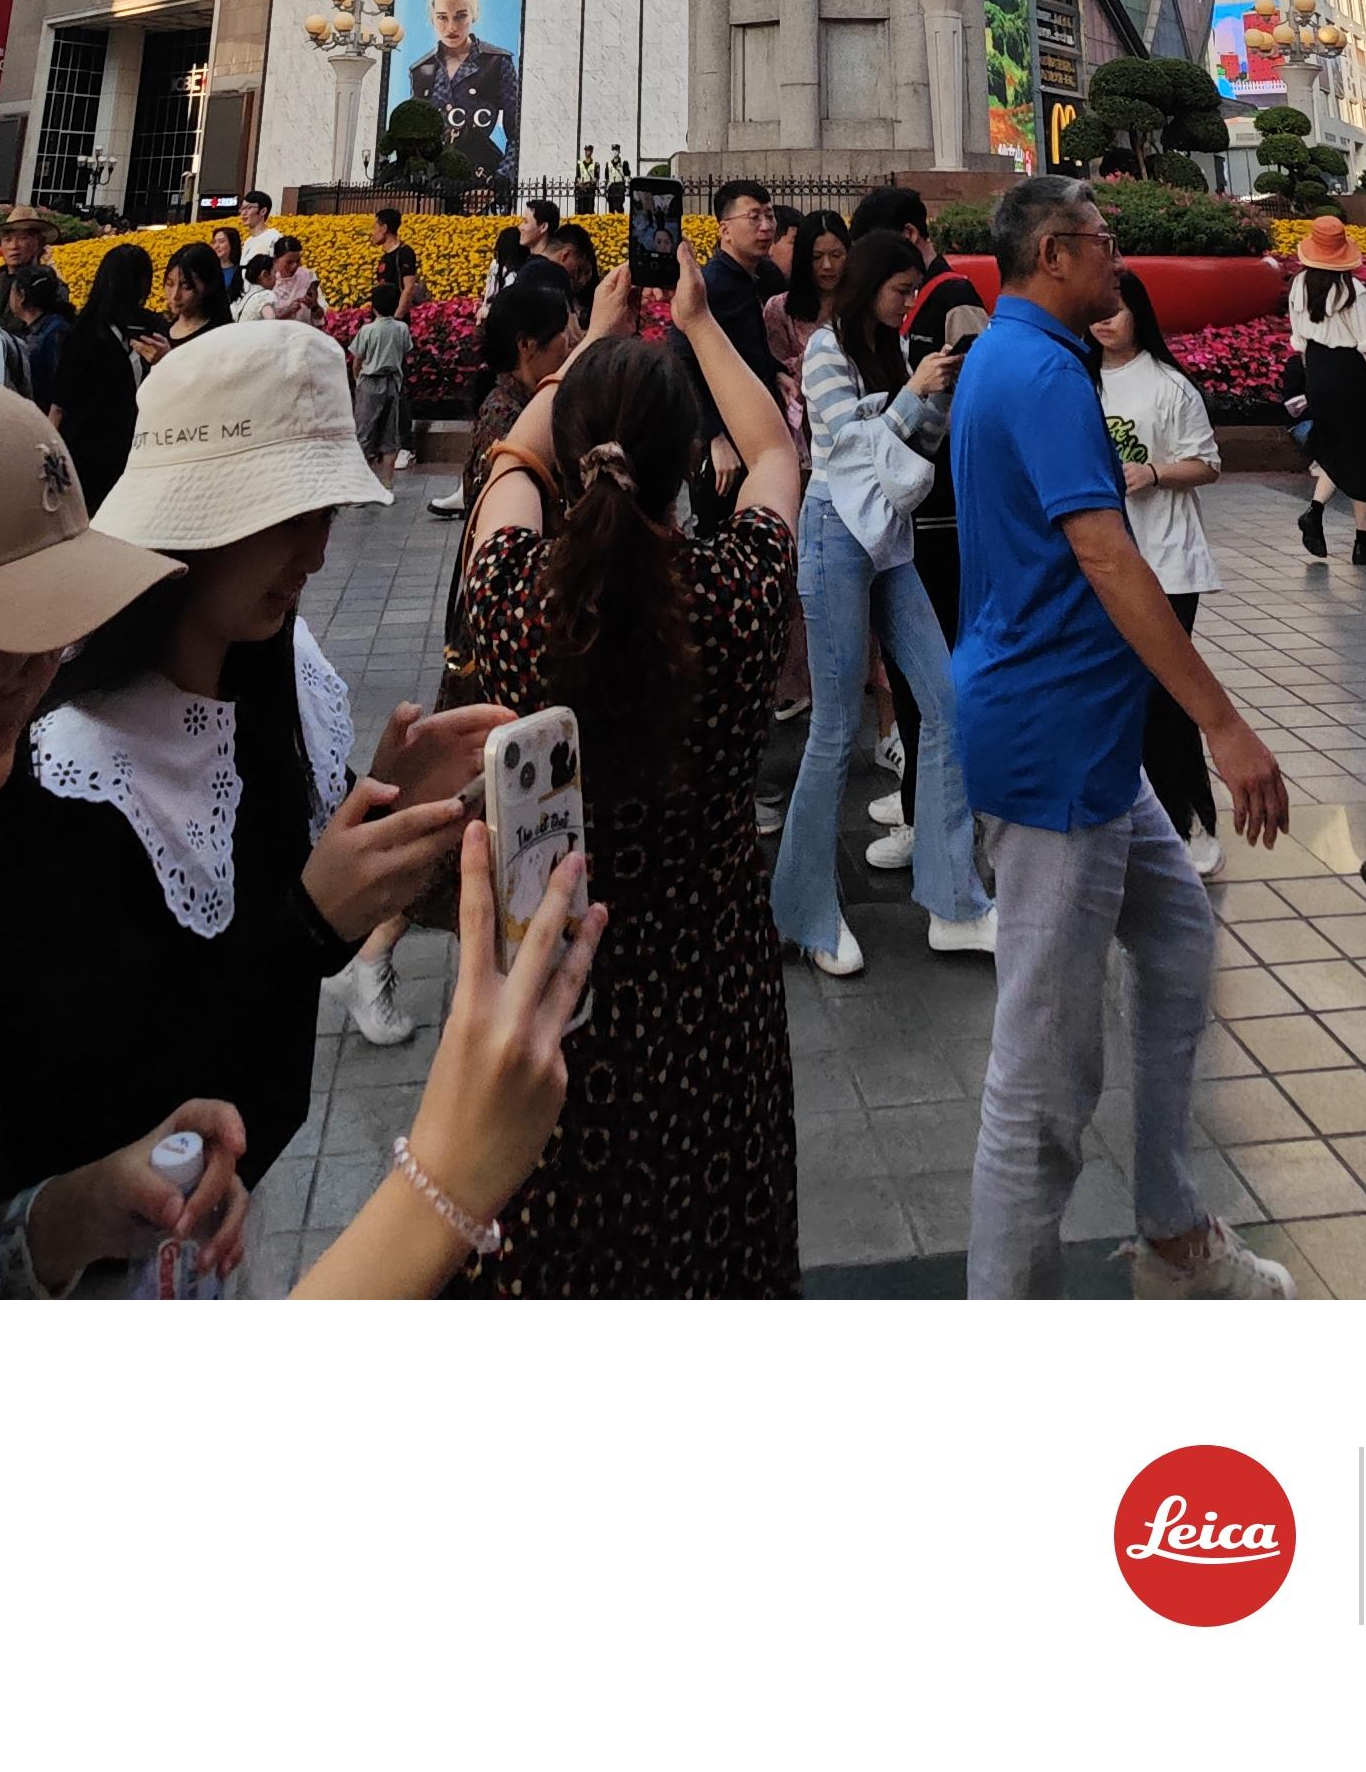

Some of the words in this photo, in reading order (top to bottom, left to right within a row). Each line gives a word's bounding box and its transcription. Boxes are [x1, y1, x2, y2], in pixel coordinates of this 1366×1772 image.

[437, 106, 504, 128] CCI
[152, 425, 210, 446] LEAVE
[221, 419, 253, 439] ME
